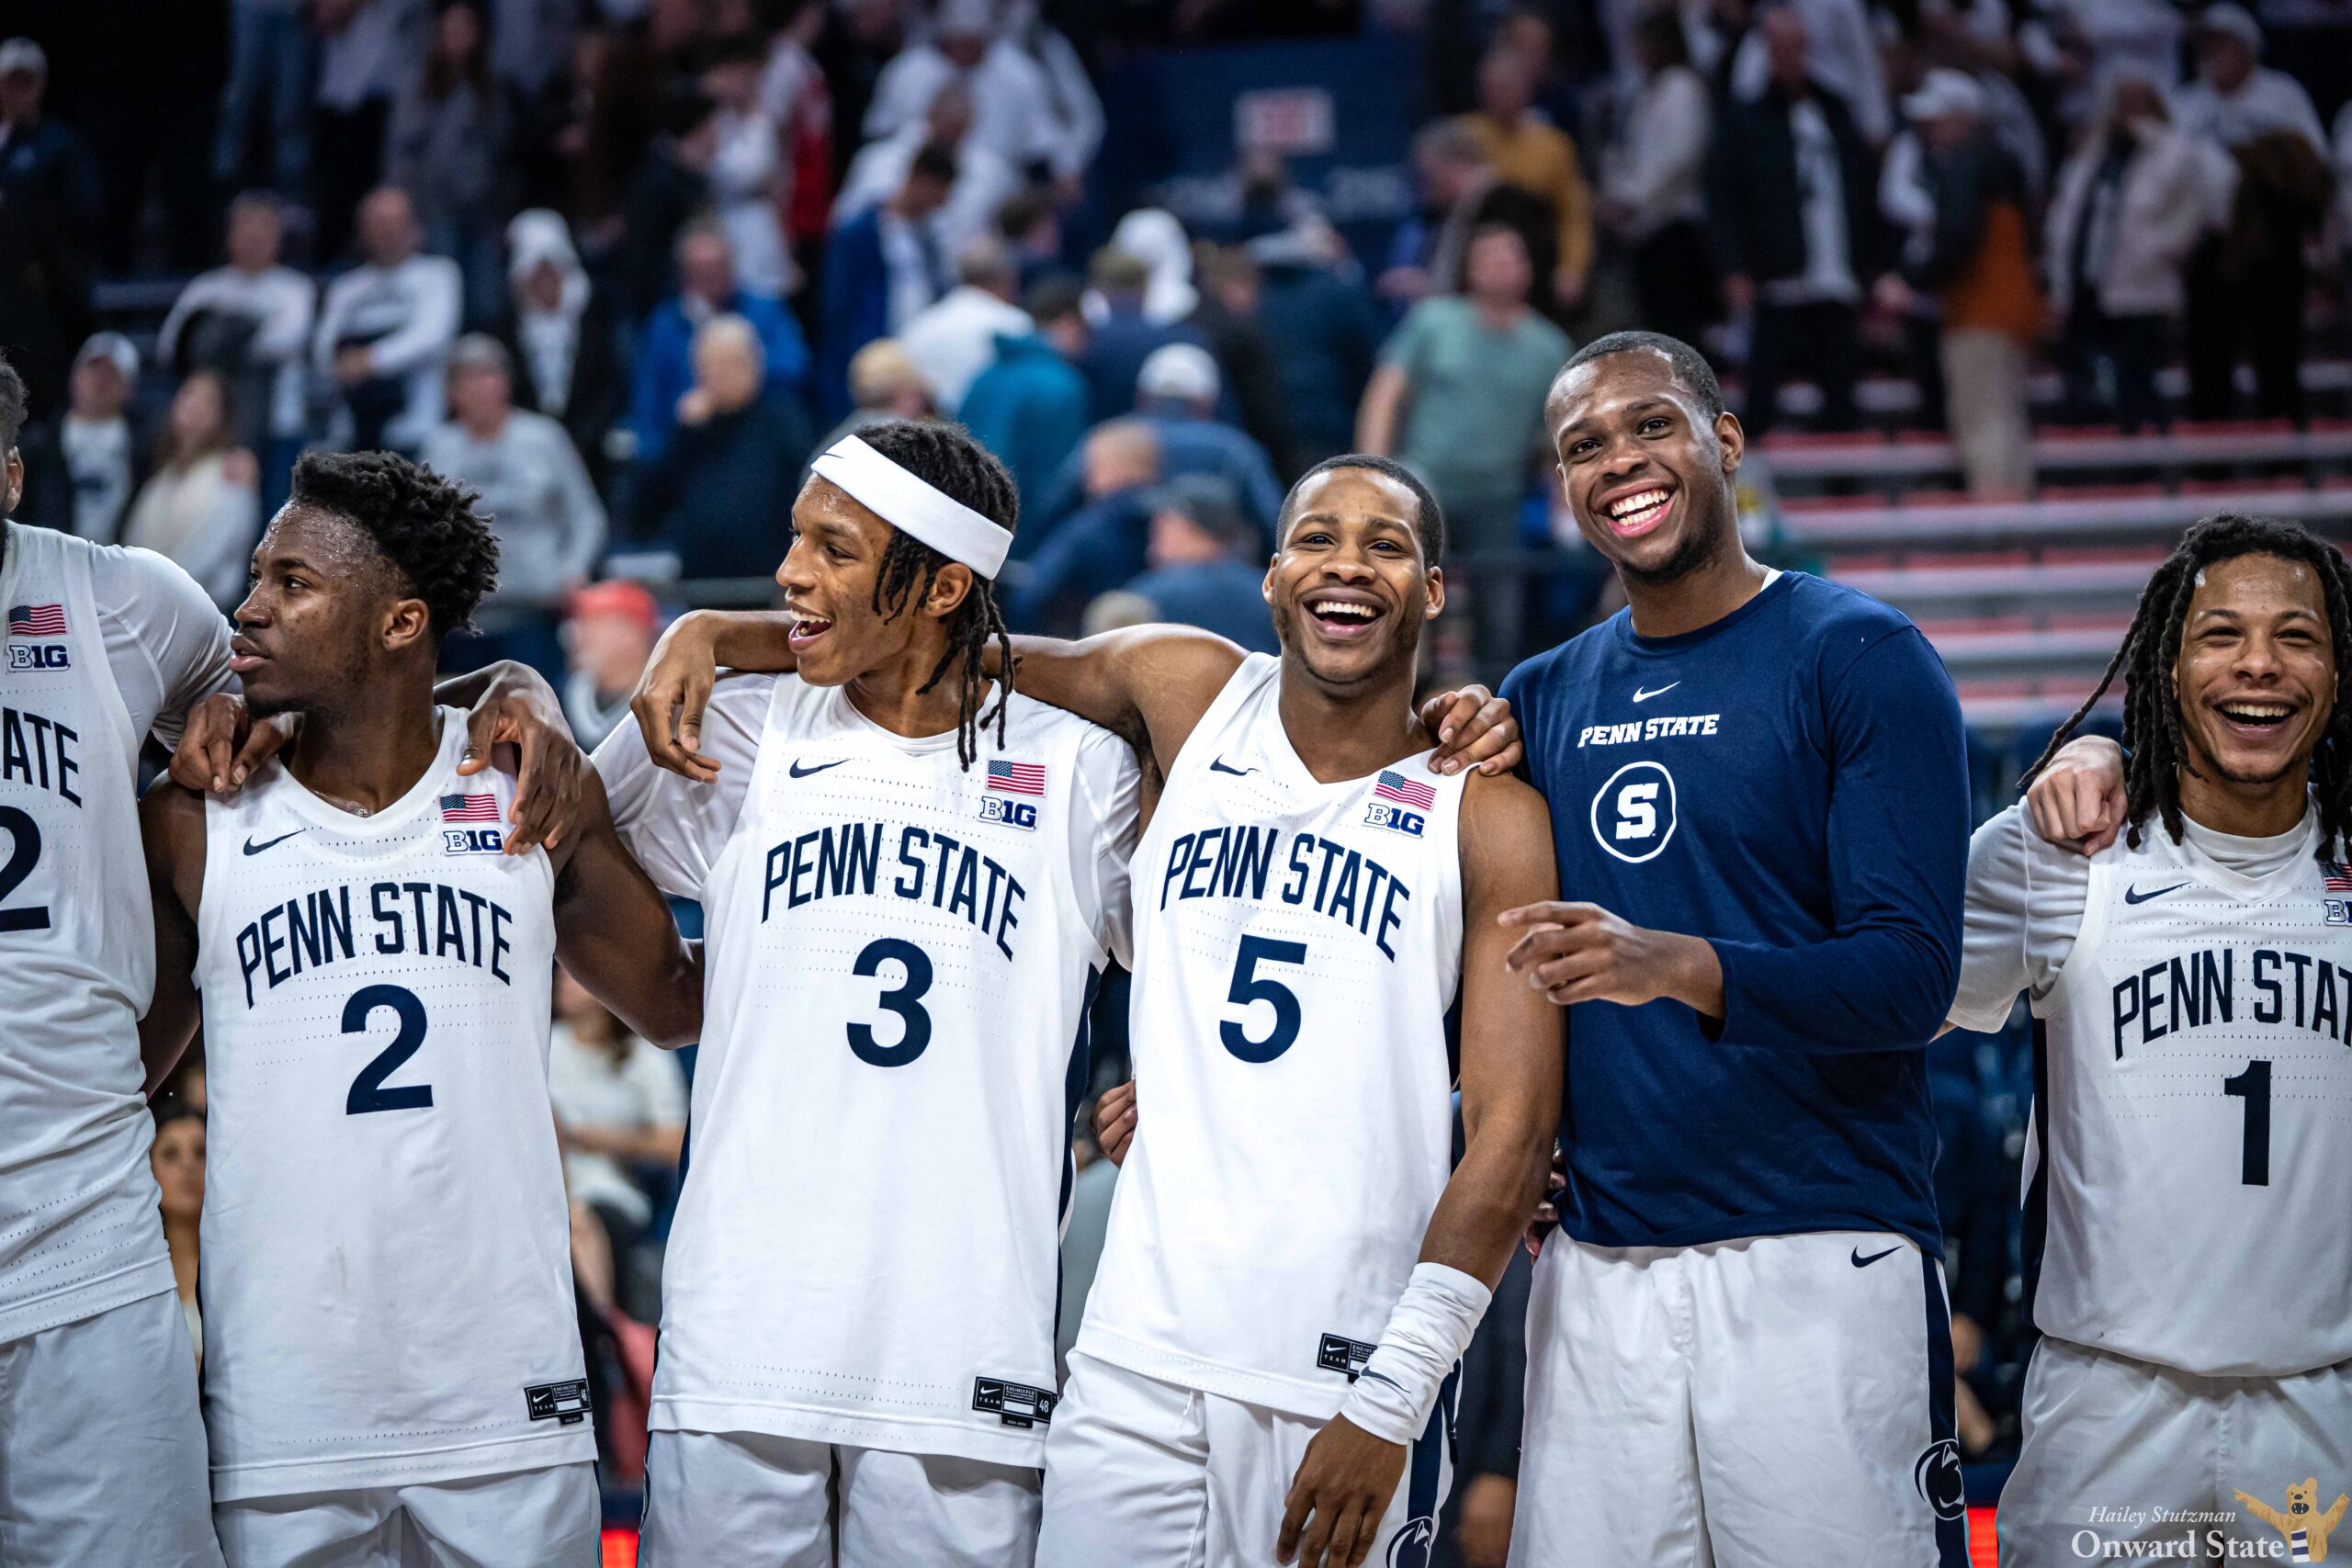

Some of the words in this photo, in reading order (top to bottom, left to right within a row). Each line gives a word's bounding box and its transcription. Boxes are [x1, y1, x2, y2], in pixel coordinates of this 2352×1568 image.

[1577, 721, 1643, 749] PENN
[1645, 714, 1721, 741] STATE
[1615, 783, 1659, 840] S
[235, 885, 356, 1009] PENN
[370, 881, 513, 987] STATE
[761, 822, 884, 925] PENN
[894, 825, 1027, 963] STATE
[1159, 824, 1279, 912] PENN
[1282, 832, 1411, 964] STATE
[340, 983, 434, 1115] 2
[846, 938, 934, 1068] 3
[1219, 933, 1308, 1064] 5
[2112, 948, 2233, 1061] PENN
[2223, 1060, 2272, 1187] 1
[534, 1404, 554, 1412] TEAM
[978, 1396, 1001, 1405] TEAM
[1005, 1385, 1035, 1395] ENGINEERED
[1039, 1399, 1049, 1413] 48
[1324, 1354, 1346, 1364] TEAM
